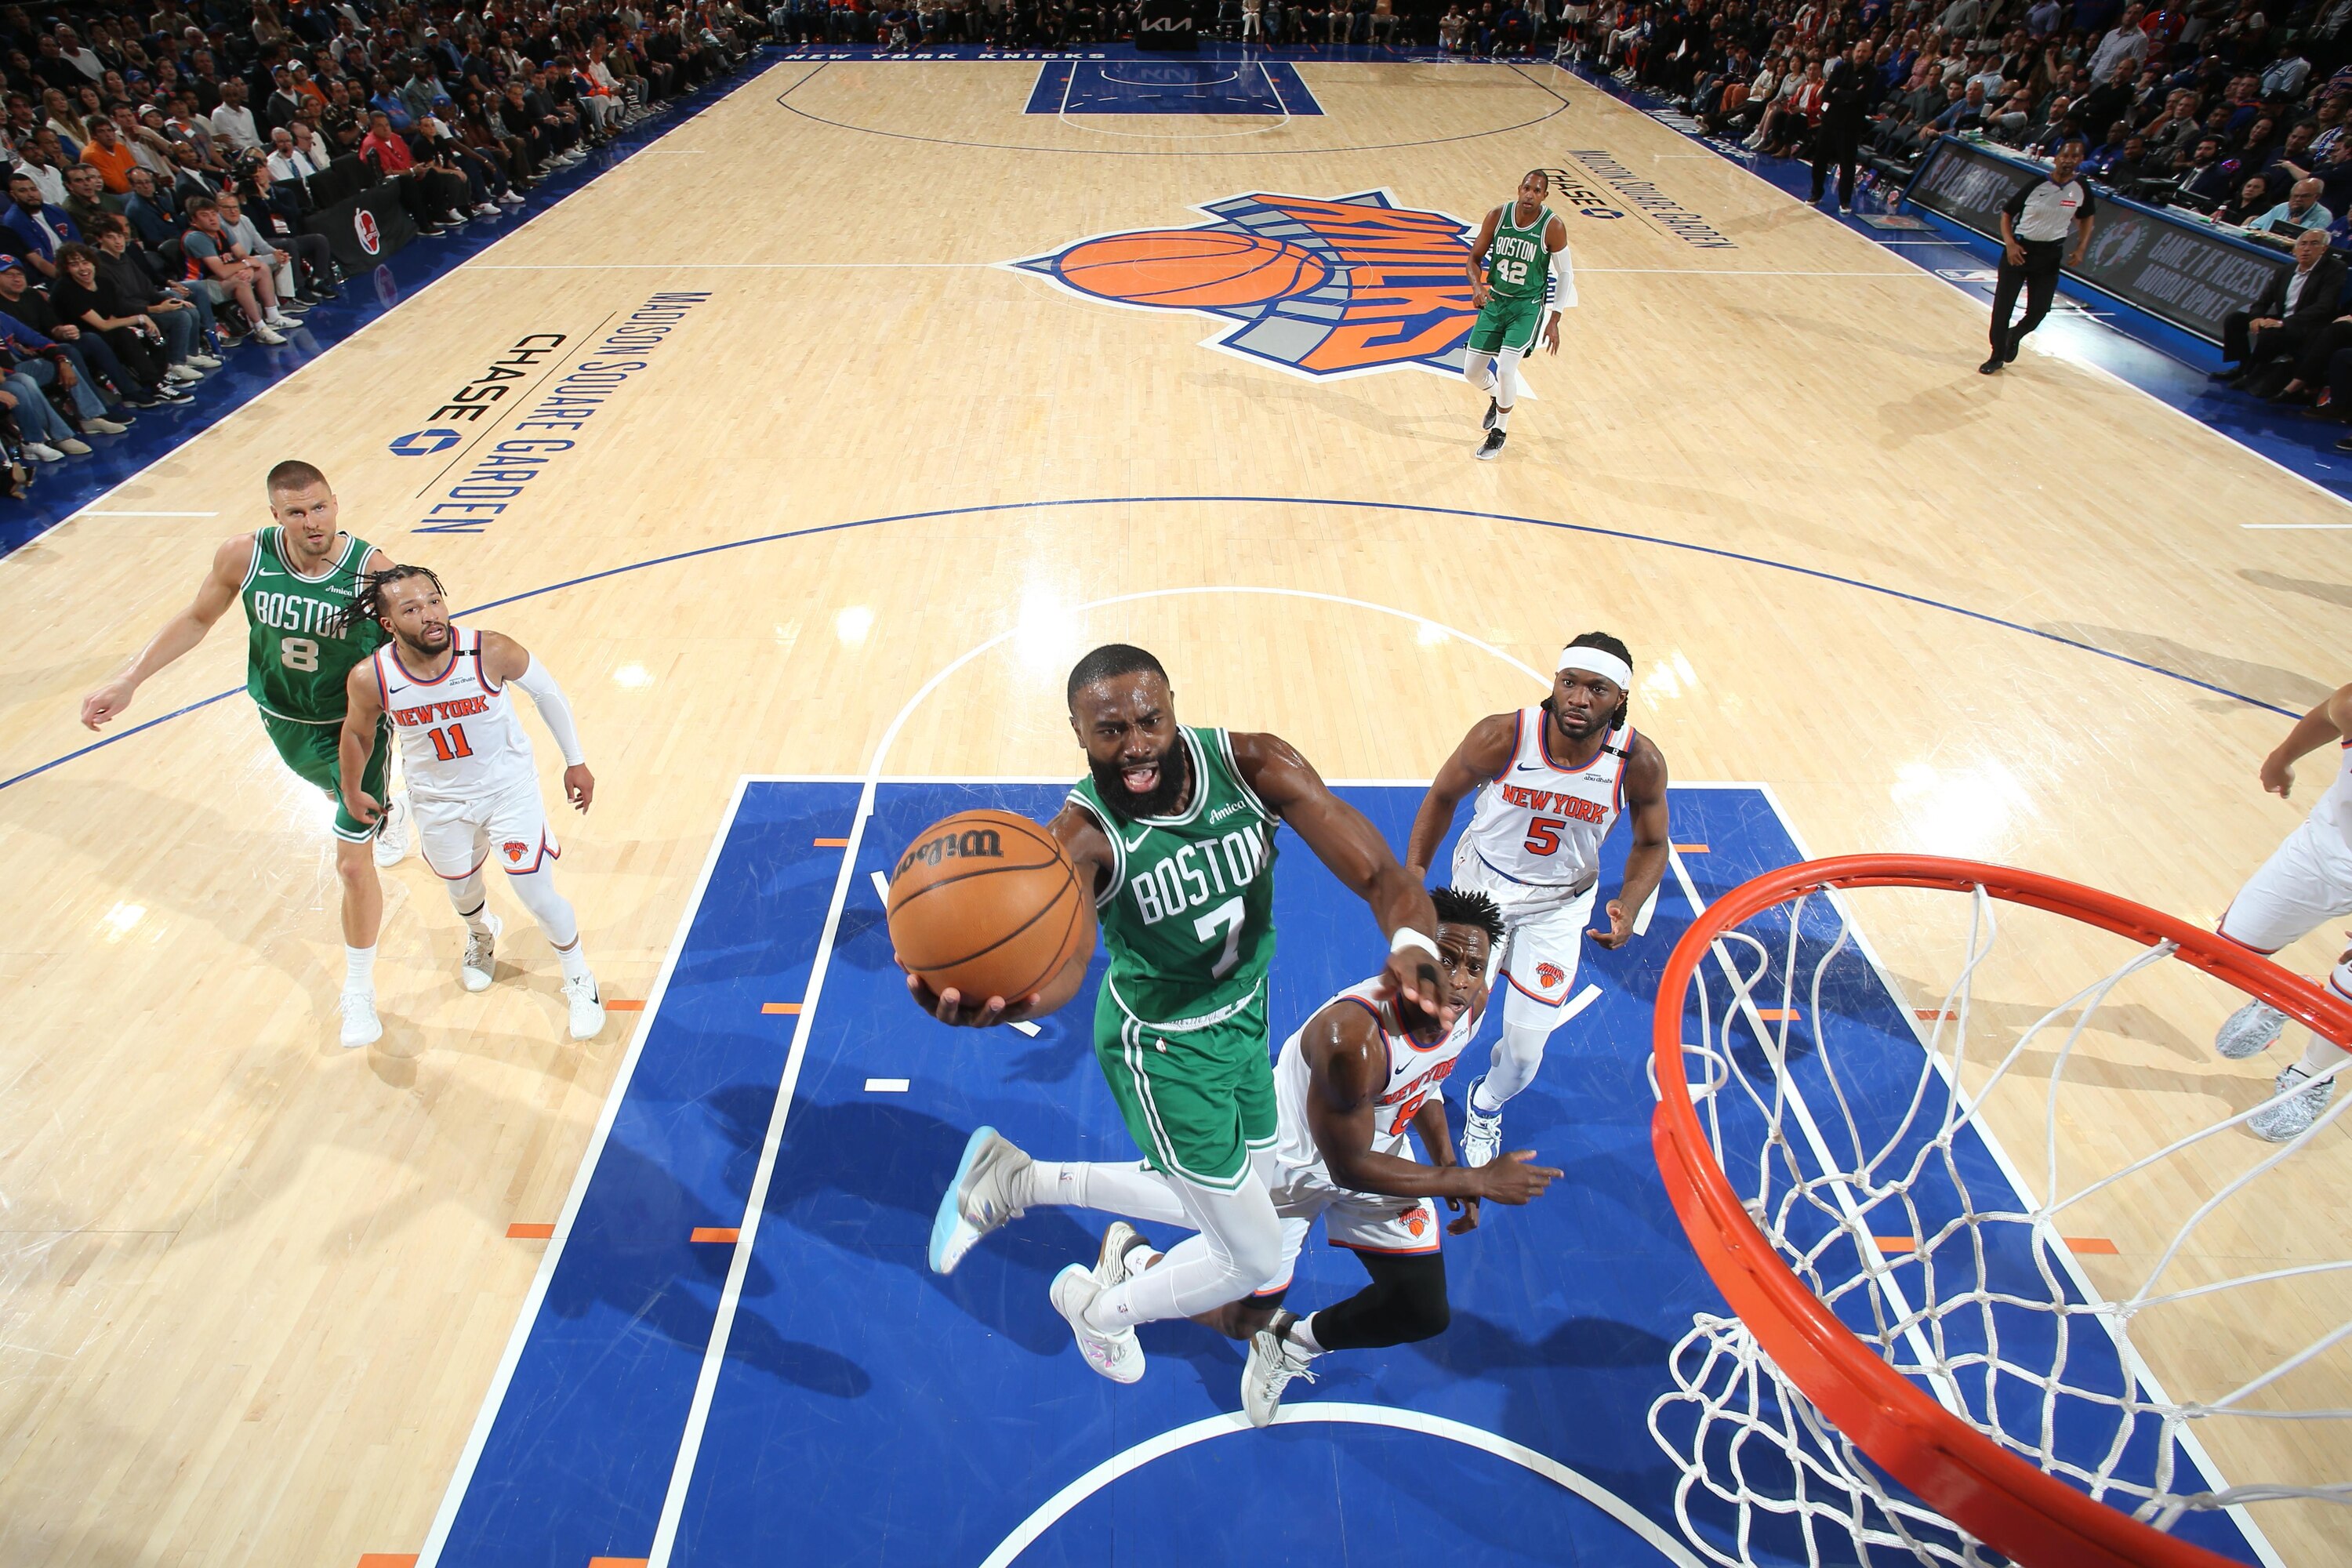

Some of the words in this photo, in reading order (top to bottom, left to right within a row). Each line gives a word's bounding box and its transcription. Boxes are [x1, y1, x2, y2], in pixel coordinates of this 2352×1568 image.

[1537, 168, 1608, 207] CHASE
[1567, 150, 1639, 180] MADISON
[1609, 181, 1685, 211] SQUARE
[1651, 213, 1739, 249] GARDEN
[1496, 236, 1537, 263] BOSTON
[2147, 232, 2198, 272] GAME
[2206, 254, 2275, 300] NECESS
[1496, 259, 1528, 285] 42
[2132, 263, 2191, 304] MONDAY
[593, 292, 713, 355] MADISON
[426, 333, 567, 422] CHASE
[514, 361, 648, 430] SQUARE
[409, 439, 575, 533] GARDEN
[325, 585, 353, 597] Amica
[255, 590, 349, 640] BOSTON
[281, 637, 319, 673] 8
[392, 704, 434, 727] NEW
[432, 695, 490, 720] YORK
[427, 723, 474, 760] 11
[1209, 800, 1247, 825] Amica
[1502, 784, 1552, 811] NEW
[1553, 793, 1609, 825] YORK
[1524, 816, 1567, 857] 5
[1131, 821, 1272, 925] BOSTON
[1193, 895, 1246, 979] 7
[1389, 1090, 1427, 1138] 8
